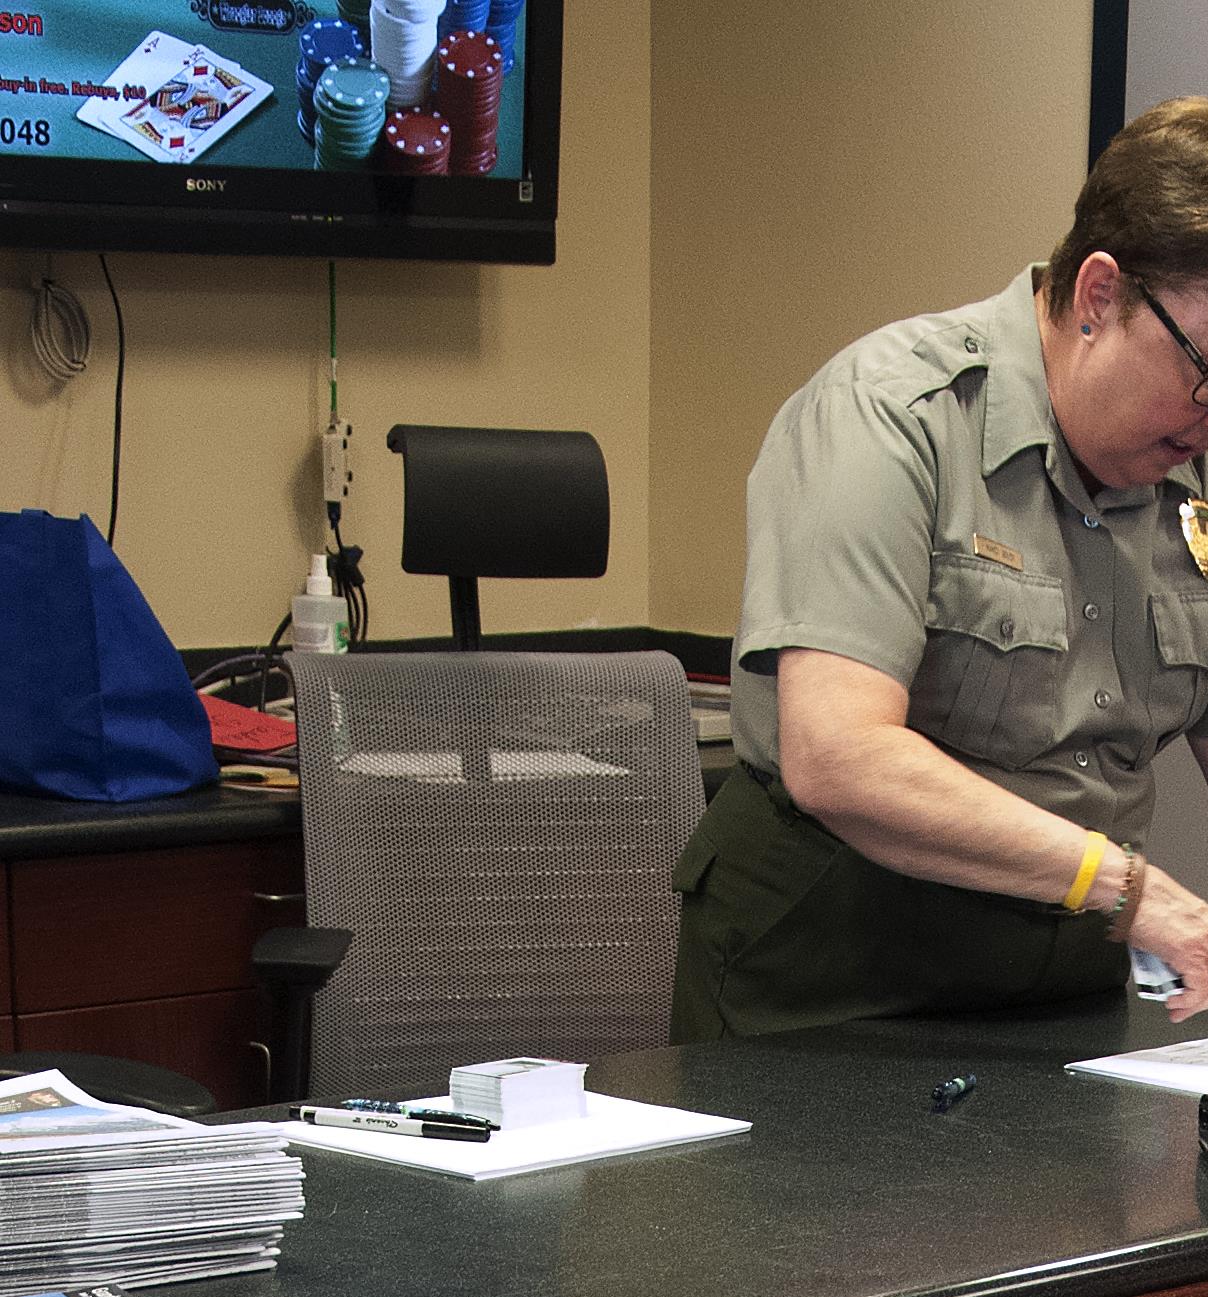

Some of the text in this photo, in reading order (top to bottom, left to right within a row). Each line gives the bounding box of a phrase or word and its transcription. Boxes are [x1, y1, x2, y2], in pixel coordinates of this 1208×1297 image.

[0, 11, 43, 36] son
[0, 117, 50, 146] 048
[186, 178, 227, 191] SONY
